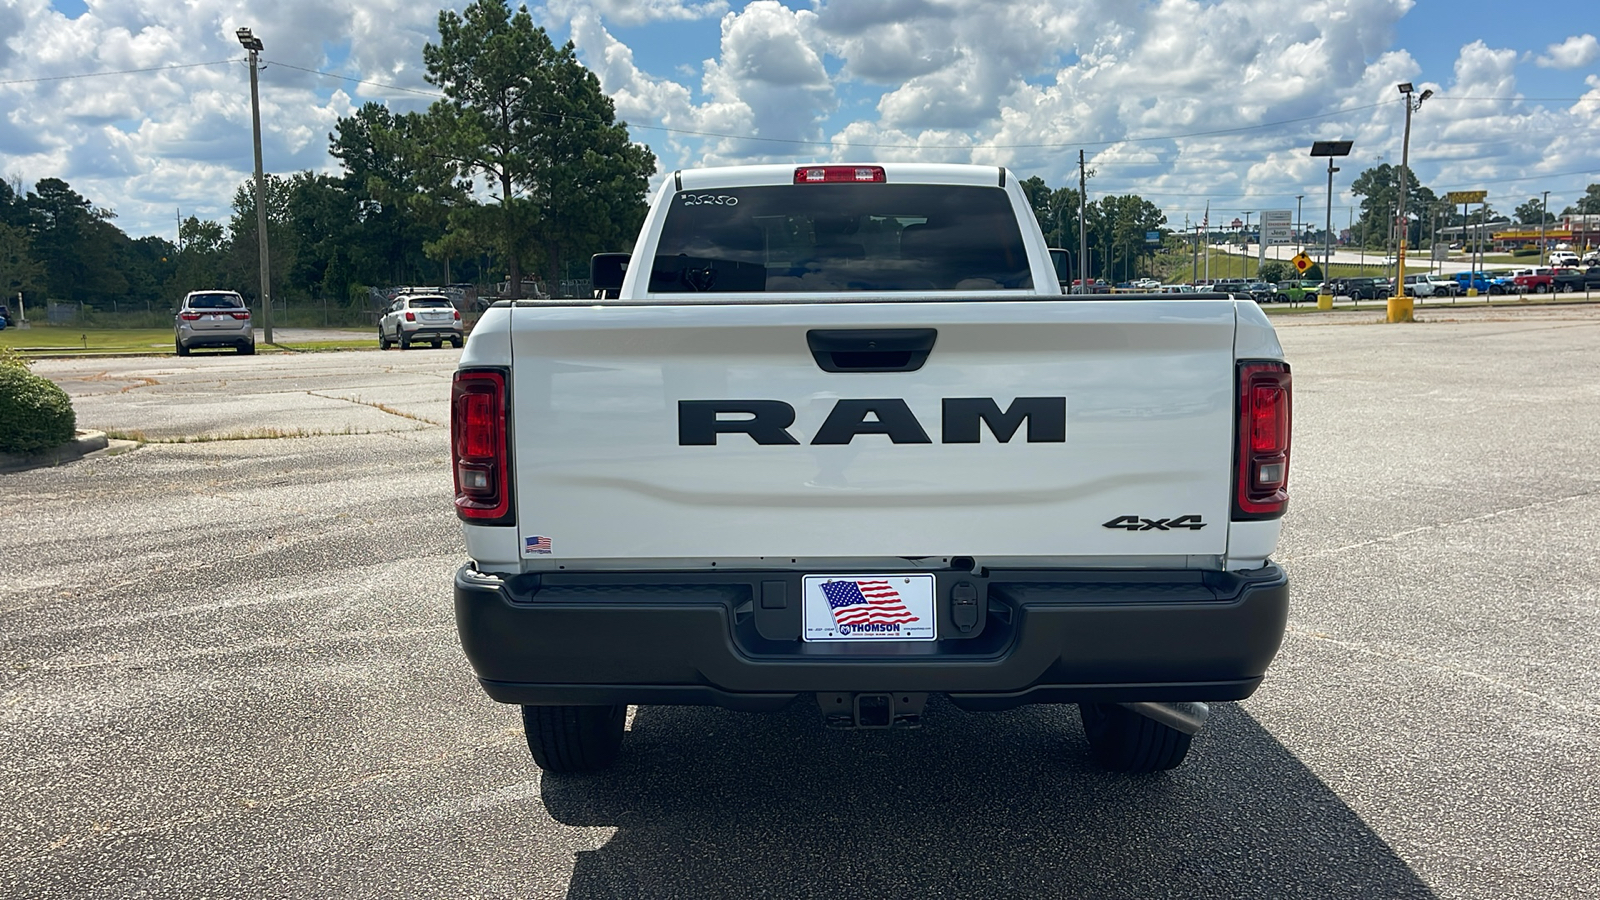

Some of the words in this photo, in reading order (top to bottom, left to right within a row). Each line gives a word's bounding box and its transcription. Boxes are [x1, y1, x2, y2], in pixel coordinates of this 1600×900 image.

[678, 397, 1066, 446] RAM
[1101, 515, 1208, 531] 4x4
[851, 624, 900, 633] THOMSON
